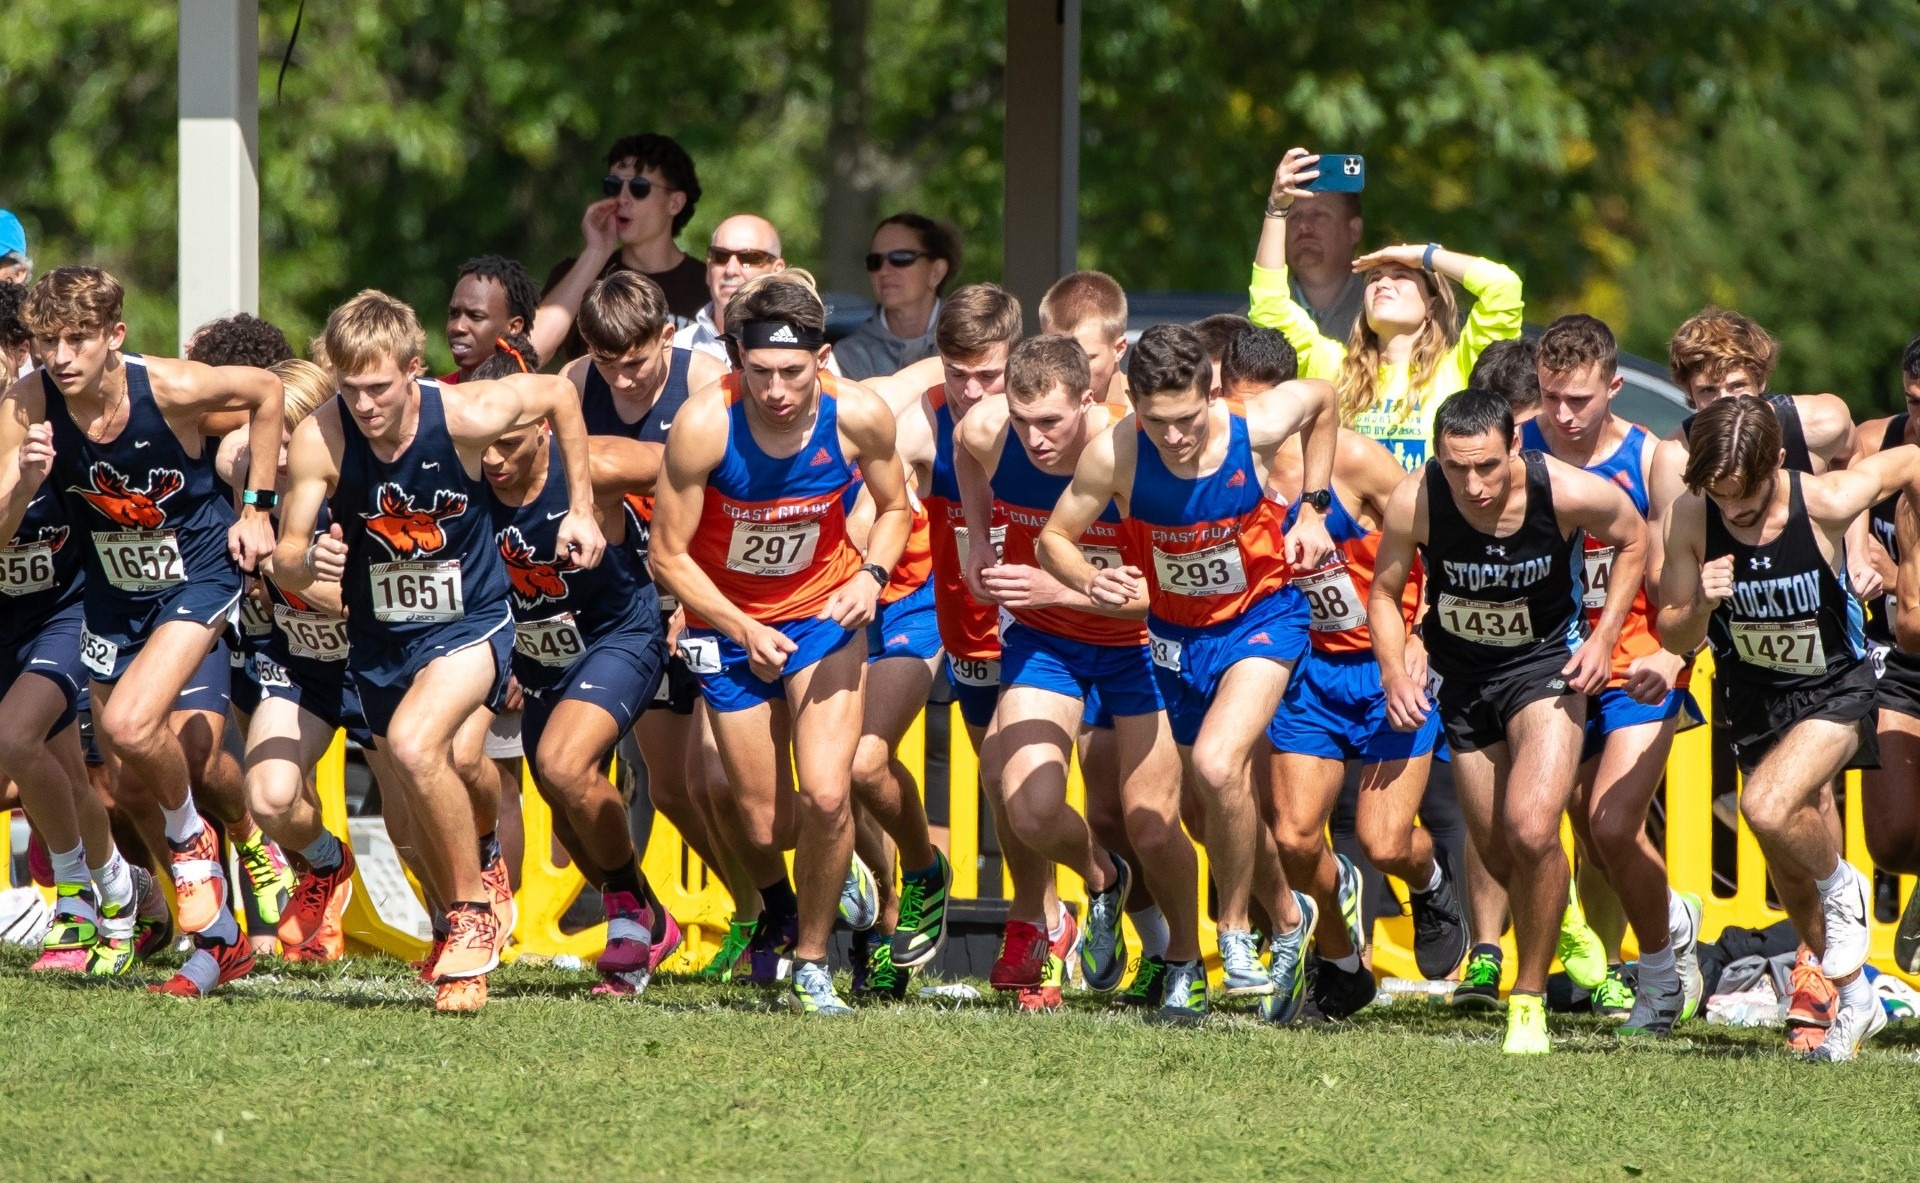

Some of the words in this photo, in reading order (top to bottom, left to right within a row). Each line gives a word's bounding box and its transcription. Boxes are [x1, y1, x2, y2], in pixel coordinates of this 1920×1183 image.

[769, 335, 798, 343] adidas
[1374, 426, 1386, 435] BY
[723, 503, 776, 521] COAST
[1010, 511, 1051, 527] COAS
[1086, 525, 1116, 537] ARD
[1151, 530, 1199, 543] COAST
[1201, 523, 1242, 541] GUA
[102, 546, 181, 580] 1652
[742, 533, 807, 565] 297
[1177, 552, 1202, 561] LEHIGH
[1166, 558, 1230, 588] 293
[1443, 555, 1552, 591] STOCKTON
[1583, 562, 1610, 596] 4
[377, 575, 457, 611] 1651
[1304, 585, 1349, 621] 98
[1466, 601, 1490, 609] LEHIGH
[1725, 569, 1820, 618] TOCKTON
[1444, 610, 1529, 637] 1434
[516, 628, 581, 657] 649
[1737, 633, 1816, 664] 1427
[952, 656, 988, 681] 296
